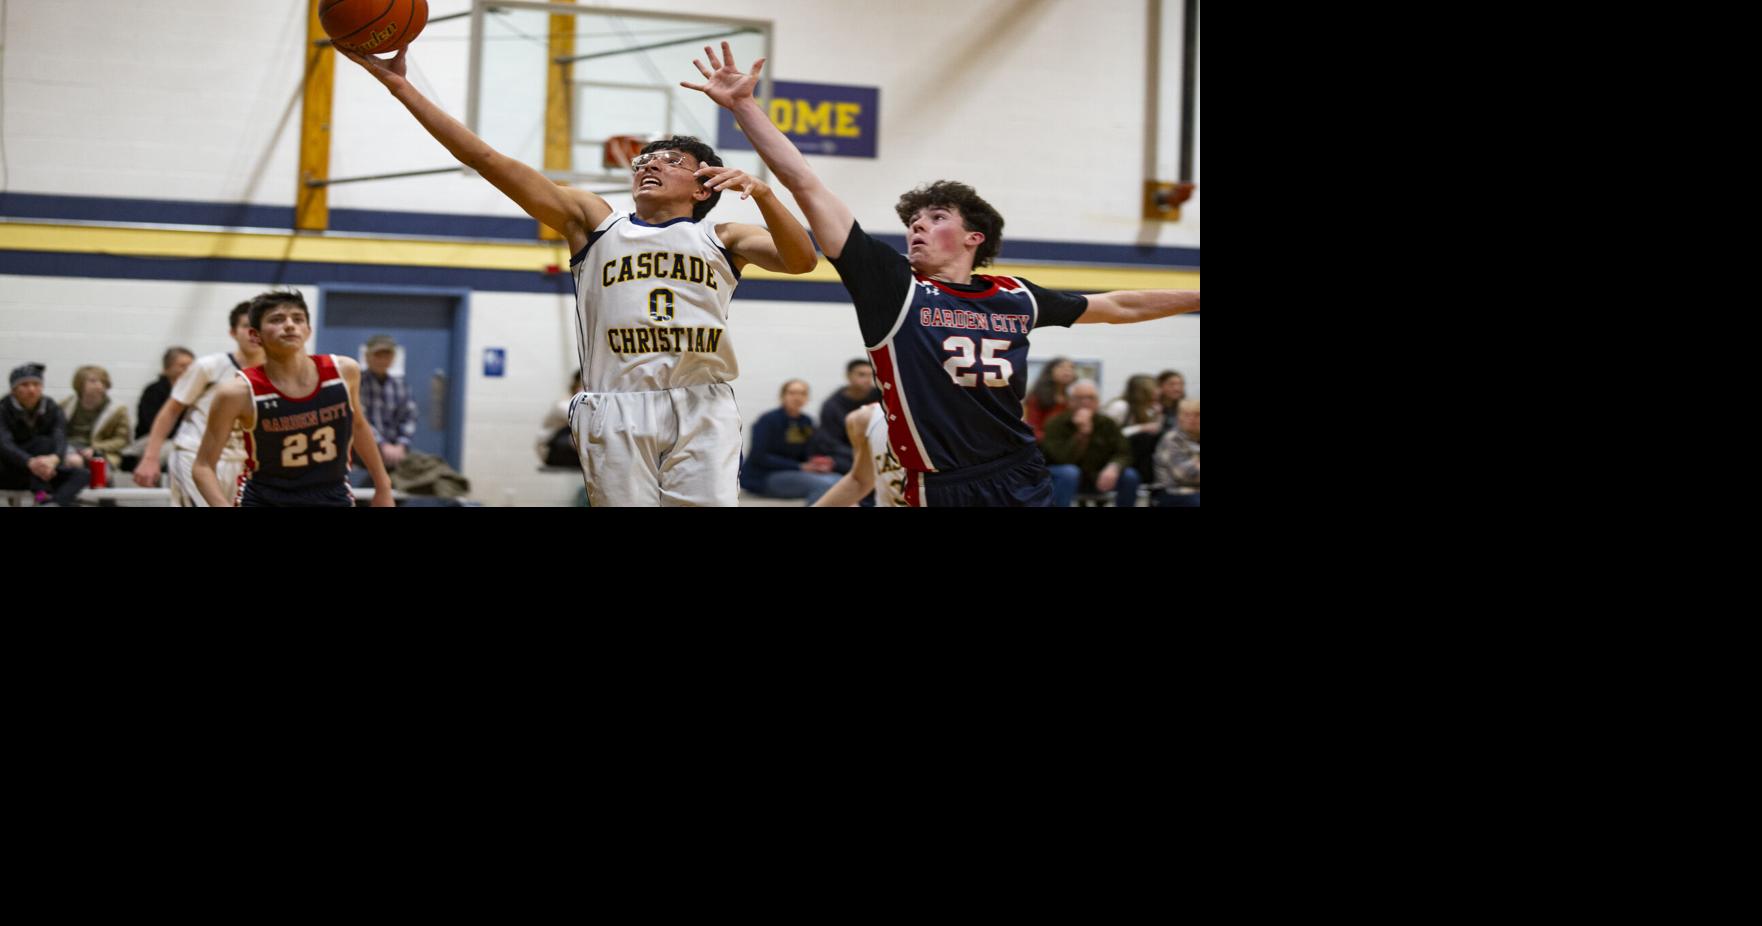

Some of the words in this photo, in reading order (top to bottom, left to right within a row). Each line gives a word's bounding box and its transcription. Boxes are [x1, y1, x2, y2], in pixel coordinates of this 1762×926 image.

[735, 97, 862, 138] OME
[602, 251, 718, 291] CASCADE
[648, 287, 675, 322] 0
[920, 307, 989, 331] GARDEN
[990, 313, 1030, 334] CITY
[607, 326, 723, 354] CHRISTIAN
[942, 335, 1014, 388] 25
[319, 402, 347, 422] CITY
[281, 426, 337, 467] 23
